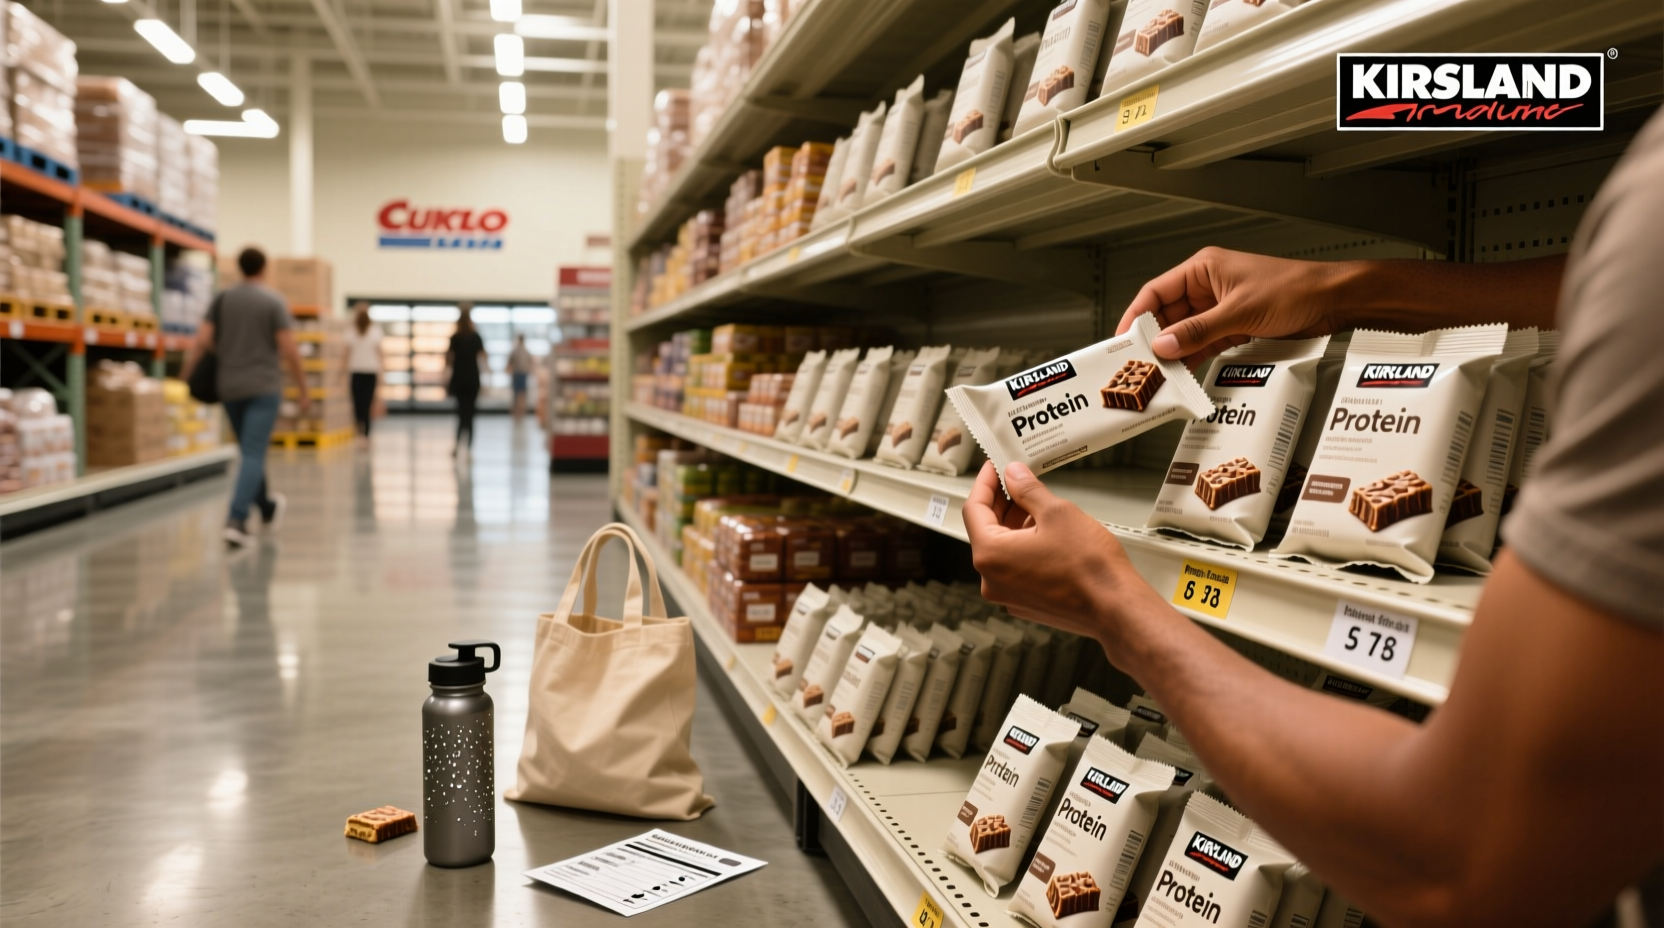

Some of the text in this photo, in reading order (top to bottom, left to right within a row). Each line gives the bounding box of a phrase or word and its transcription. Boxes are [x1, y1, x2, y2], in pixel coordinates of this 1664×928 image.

[1011, 392, 1089, 438] Protein
[1192, 403, 1256, 426] otein
[1330, 407, 1421, 434] Protein
[1184, 580, 1196, 600] 6
[1369, 632, 1397, 662] 78
[1058, 797, 1107, 842] Protein
[1156, 870, 1222, 924] Protein
